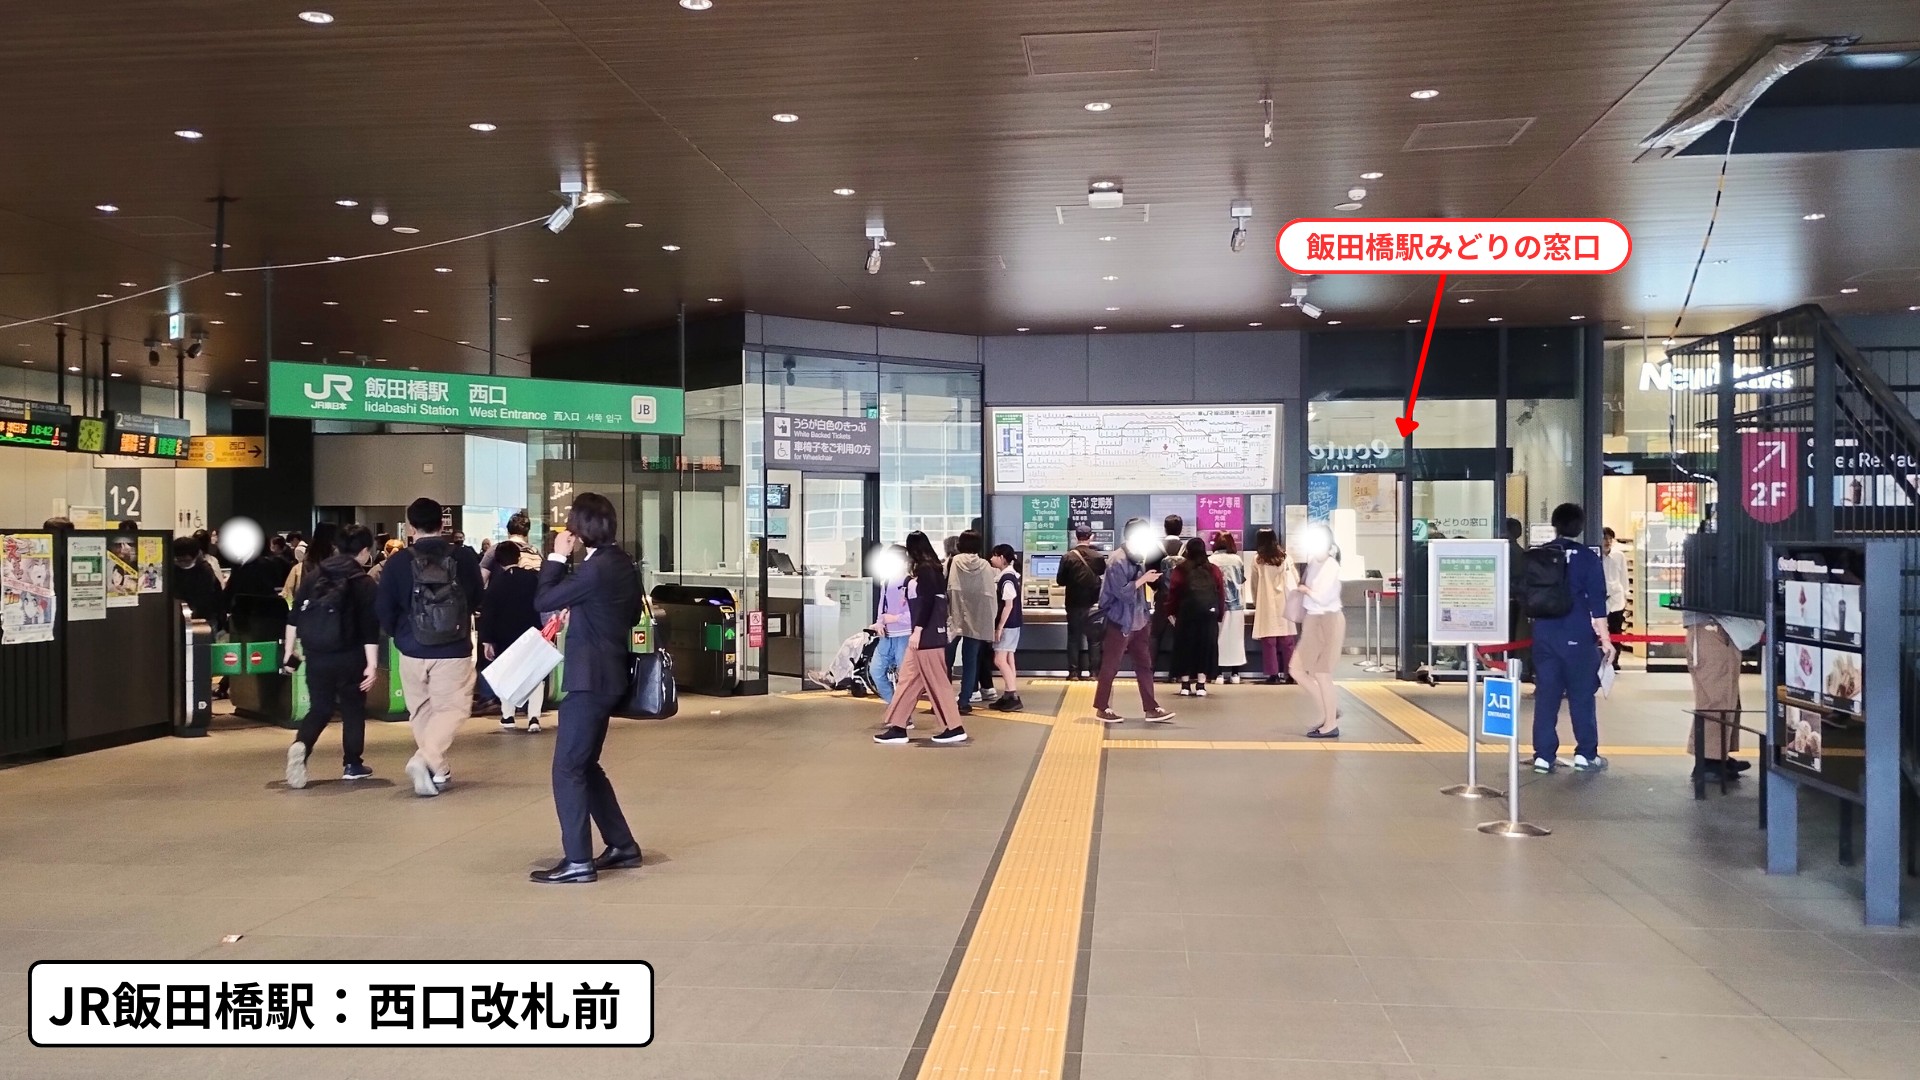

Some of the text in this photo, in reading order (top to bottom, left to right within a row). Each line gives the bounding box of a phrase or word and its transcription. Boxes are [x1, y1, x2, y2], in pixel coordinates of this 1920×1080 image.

[304, 374, 353, 402] JR
[364, 377, 507, 405] 飯田橋駅 西口
[311, 401, 348, 411] JR東日本
[364, 401, 547, 421] Iidabashi Station West Entrance
[637, 404, 651, 415] JB
[116, 413, 124, 427] 2
[793, 418, 867, 432] うらが白色のきっぷ
[31, 424, 54, 436] 16:42
[810, 431, 831, 439] Backed
[832, 432, 851, 440] Tickets
[793, 441, 872, 455] 車椅子をご利用の方
[1807, 452, 1845, 469] Ce
[1750, 481, 1788, 507] 2F
[1031, 497, 1060, 509] きっぷ
[1070, 497, 1113, 509] きっぷ 定期券
[1200, 496, 1241, 509] チャージ専用
[1434, 517, 1488, 527] みどりの窓口
[634, 633, 645, 644] IC
[1488, 693, 1510, 709] 入口
